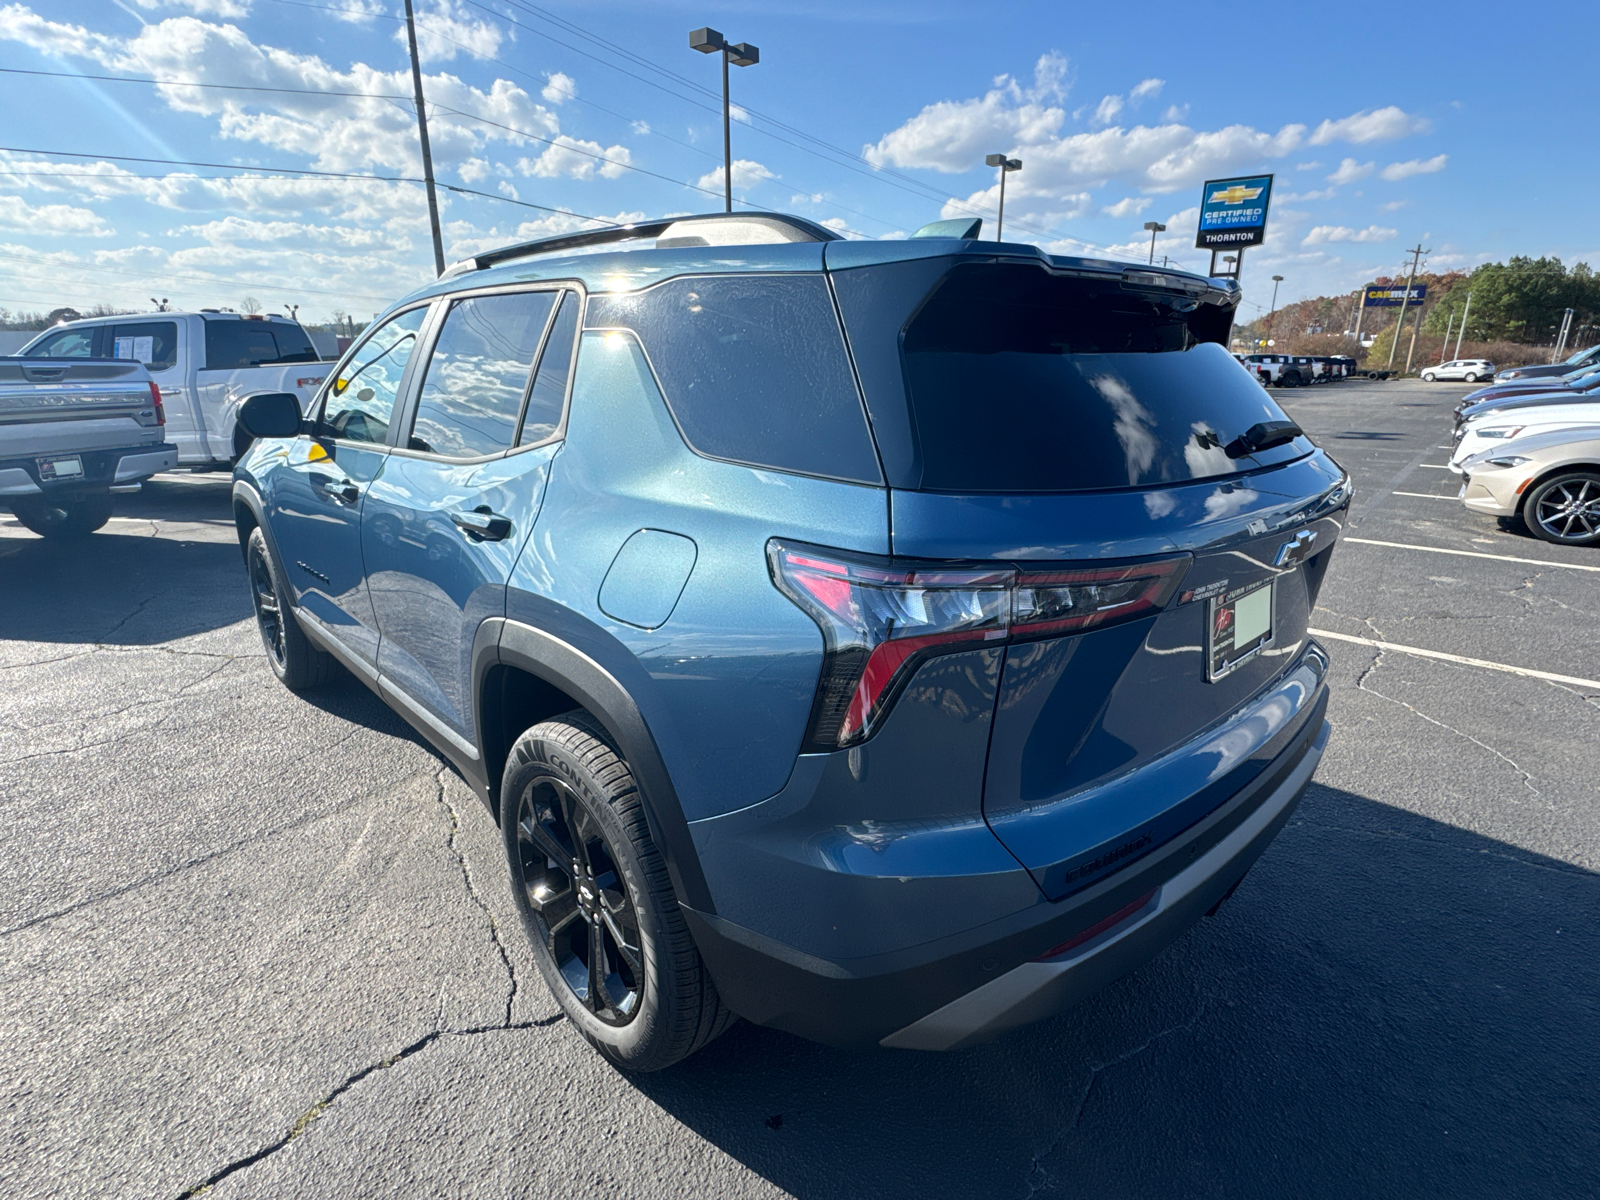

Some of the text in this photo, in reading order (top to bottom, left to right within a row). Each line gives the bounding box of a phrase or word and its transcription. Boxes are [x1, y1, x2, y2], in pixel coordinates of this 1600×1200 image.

[1204, 208, 1262, 219] CERTIFIED
[1206, 215, 1259, 225] PRE-OWNED
[1206, 232, 1254, 243] THORNTON
